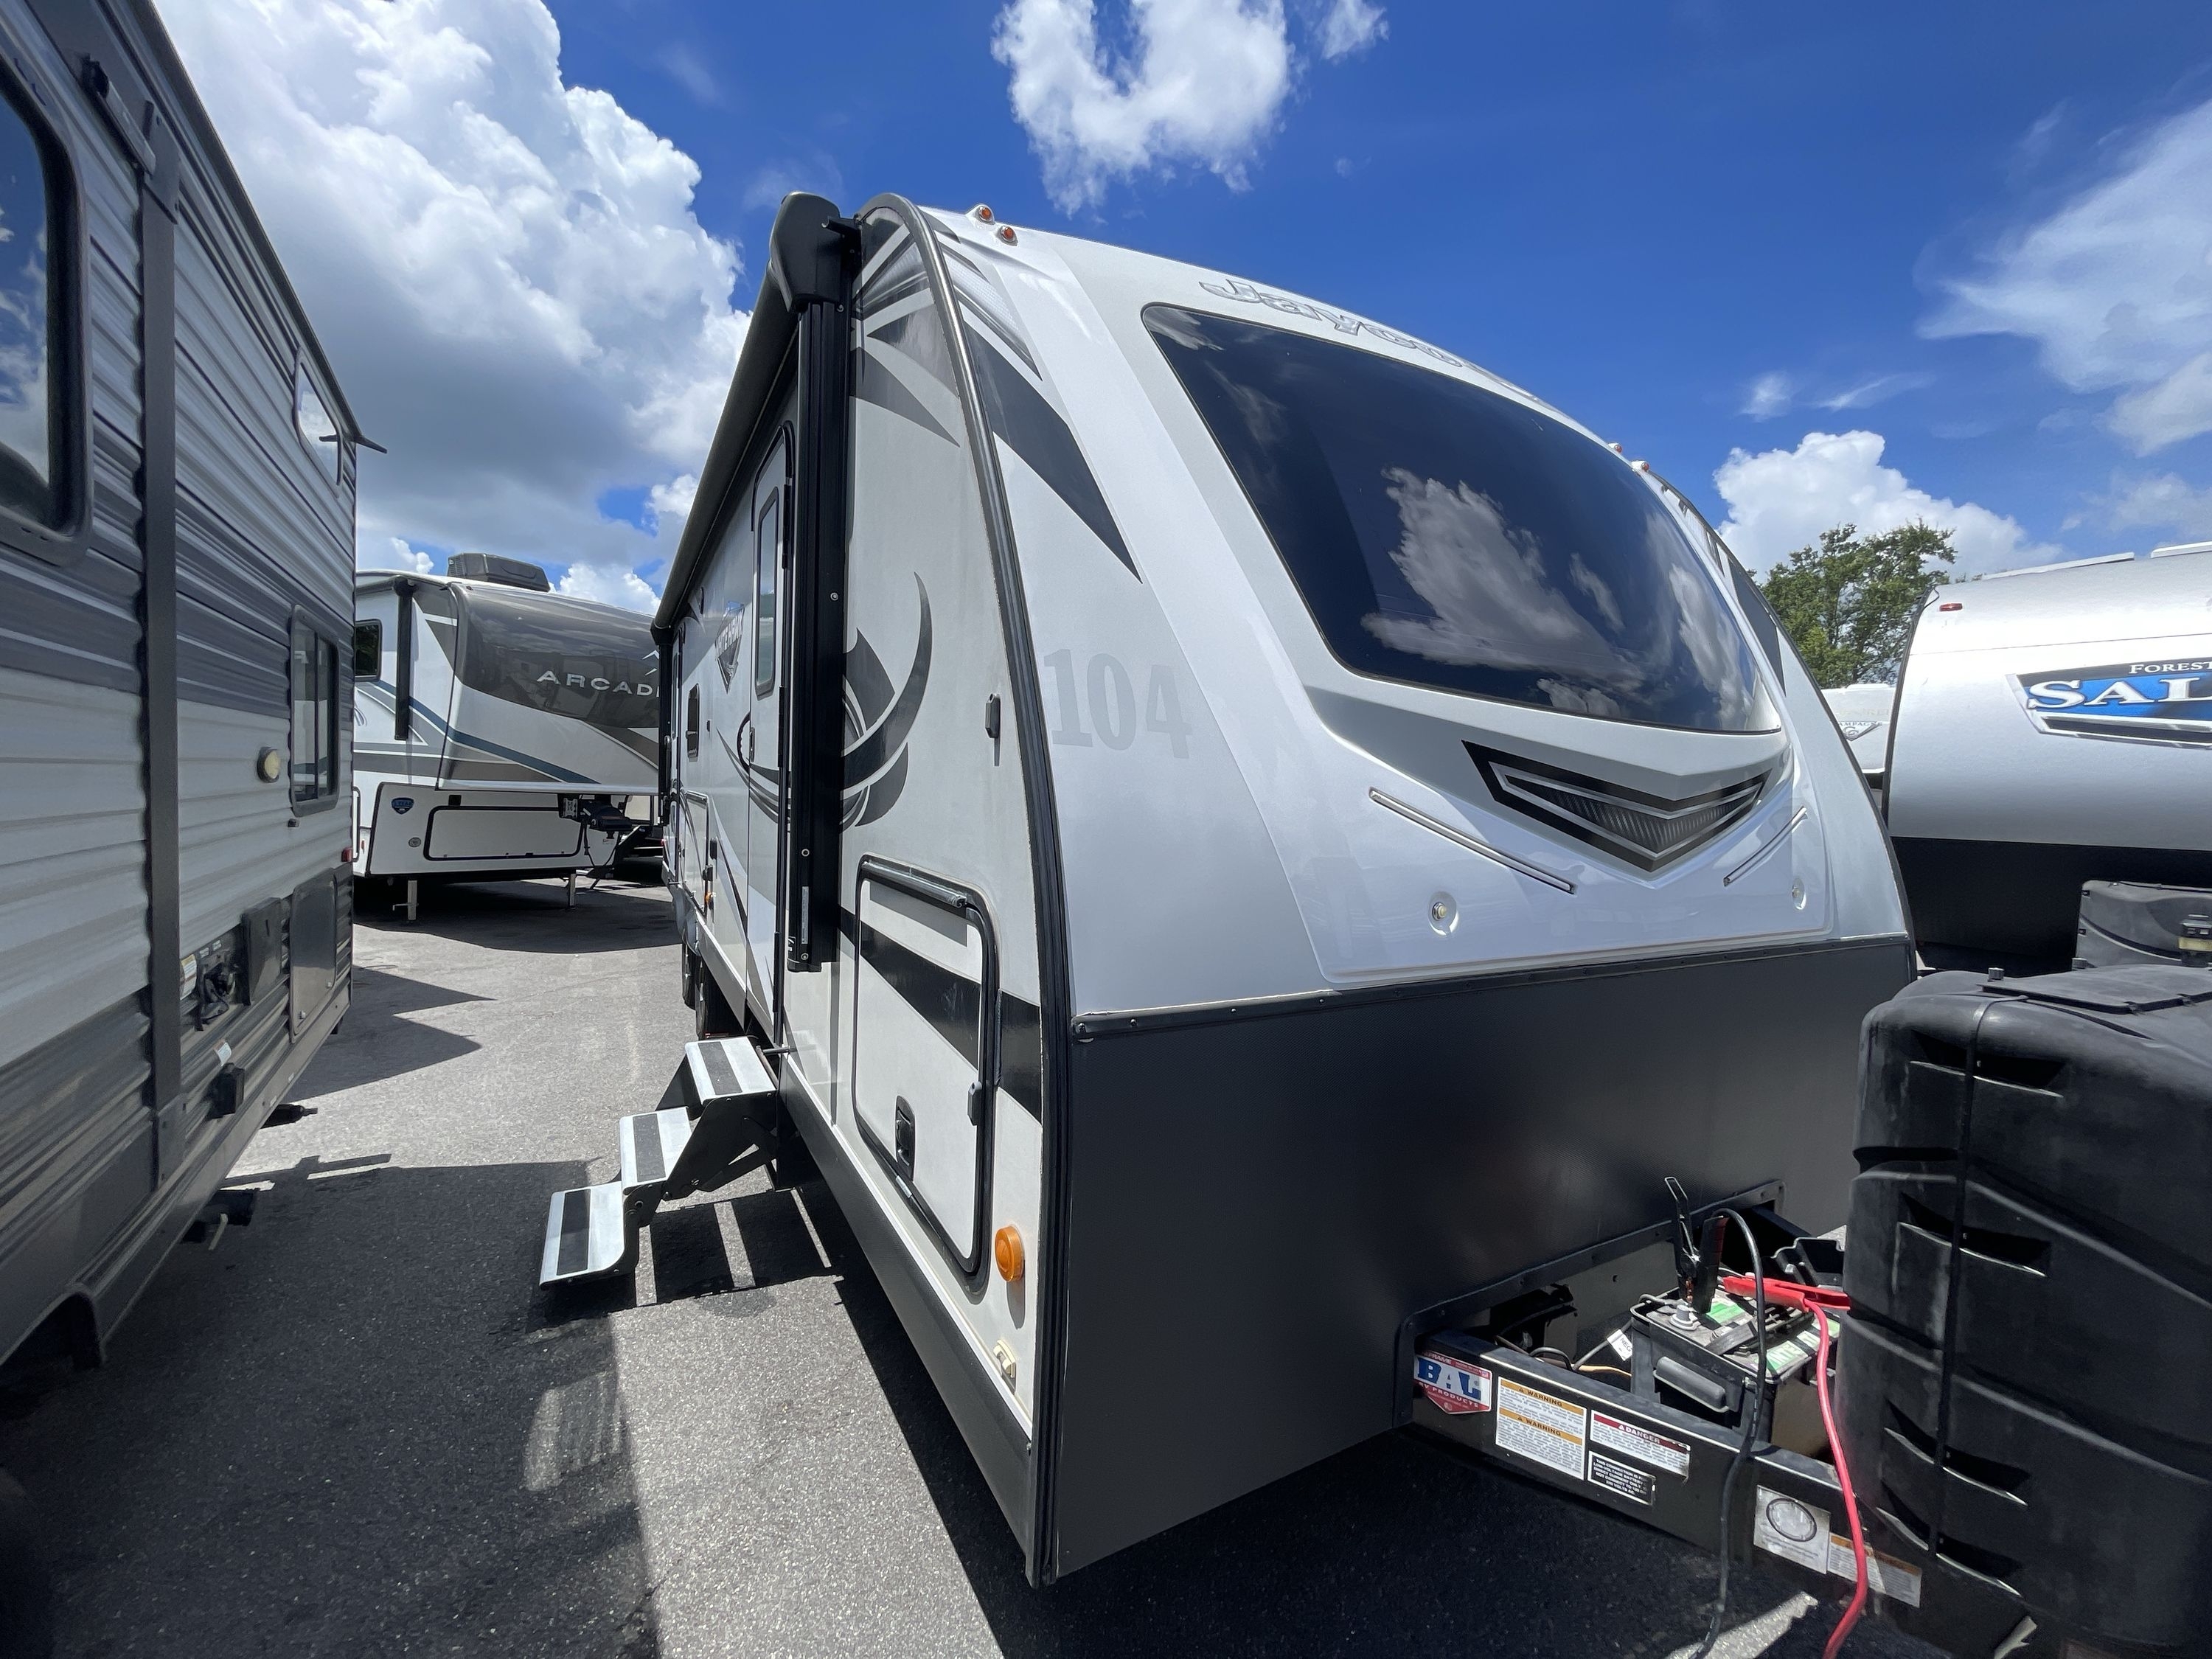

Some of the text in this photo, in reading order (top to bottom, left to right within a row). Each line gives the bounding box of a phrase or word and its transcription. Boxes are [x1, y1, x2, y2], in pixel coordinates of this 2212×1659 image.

[537, 670, 659, 698] ARCADI
[1043, 649, 1193, 759] 104
[1620, 1338, 1632, 1352] NEG
[1417, 1357, 1481, 1401] BAL
[1433, 1386, 1478, 1408] PRODUCTS
[1527, 1389, 1562, 1407] WARNING
[1526, 1419, 1562, 1436] WARNING
[1625, 1425, 1660, 1444] DANGER
